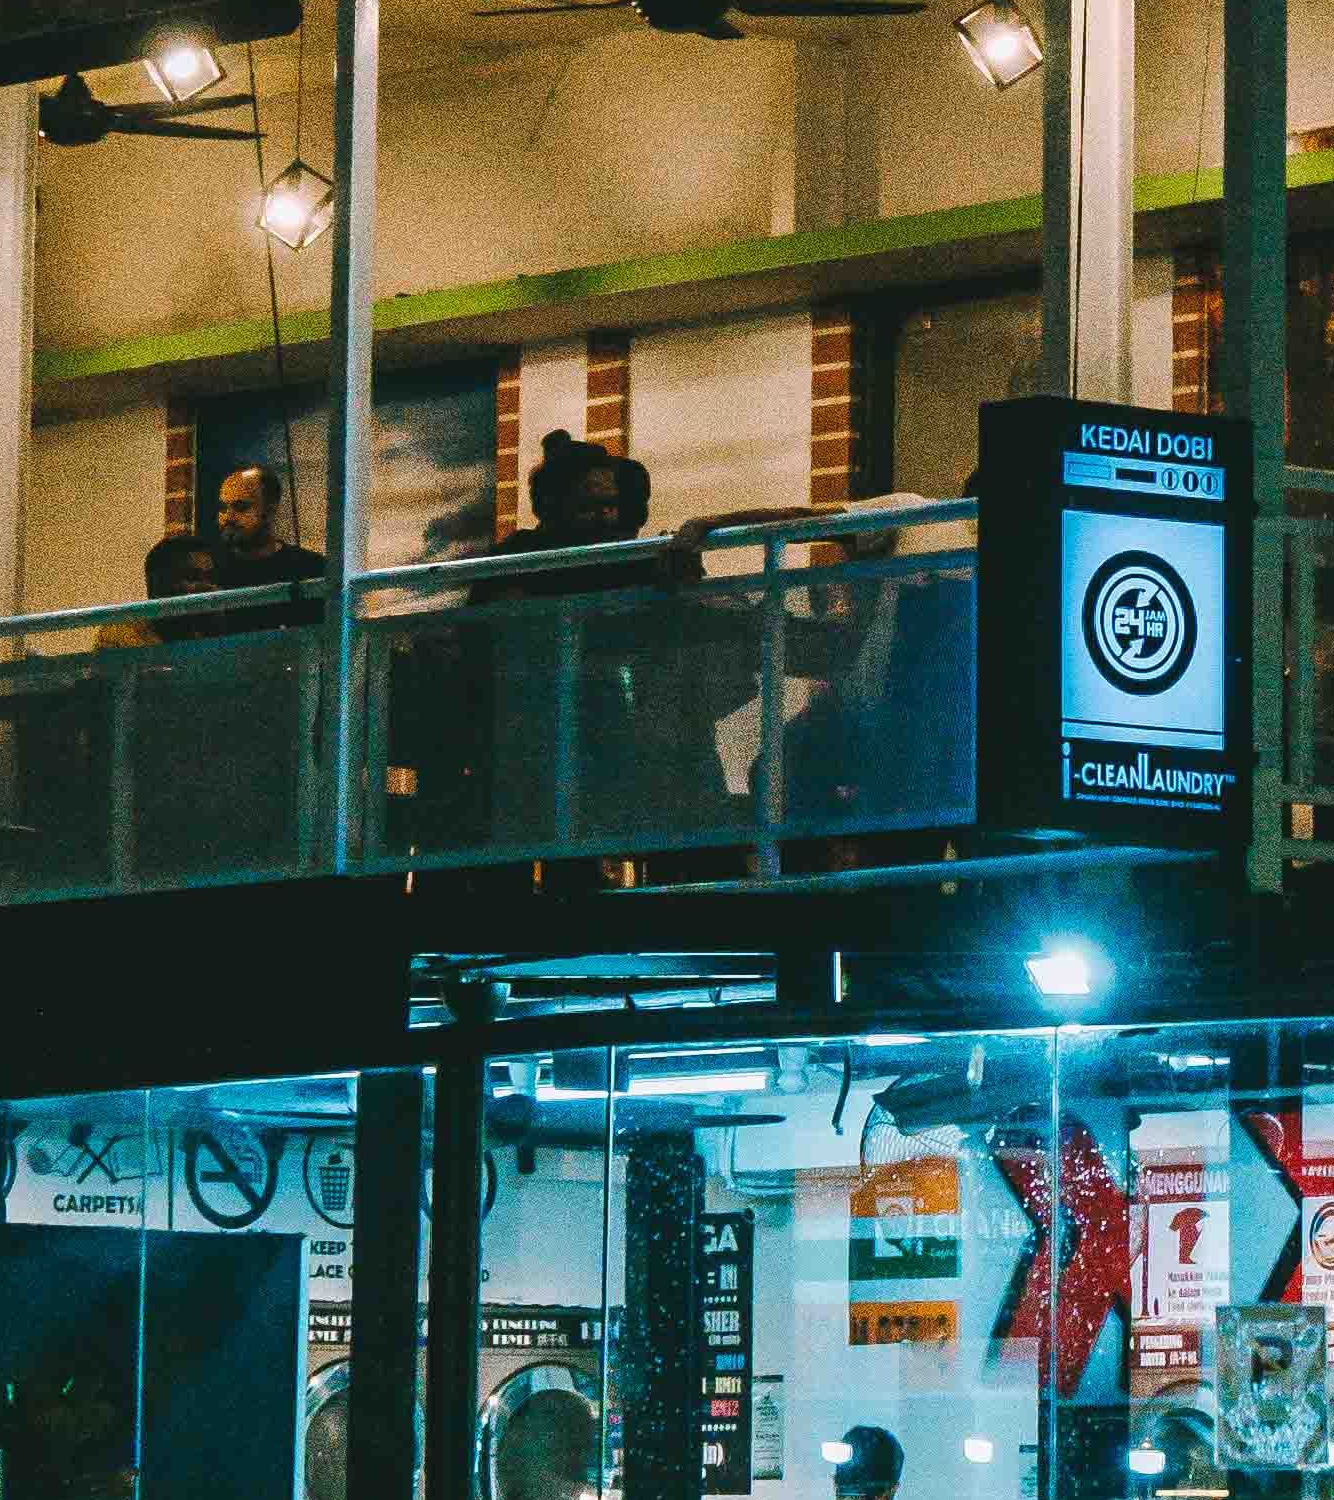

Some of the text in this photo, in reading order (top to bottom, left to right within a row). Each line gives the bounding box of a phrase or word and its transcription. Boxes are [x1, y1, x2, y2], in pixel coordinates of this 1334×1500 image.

[1081, 424, 1213, 461] KEDAI DOBI
[1114, 606, 1145, 637] 24
[1147, 621, 1164, 637] HR
[309, 1240, 347, 1256] KEEP
